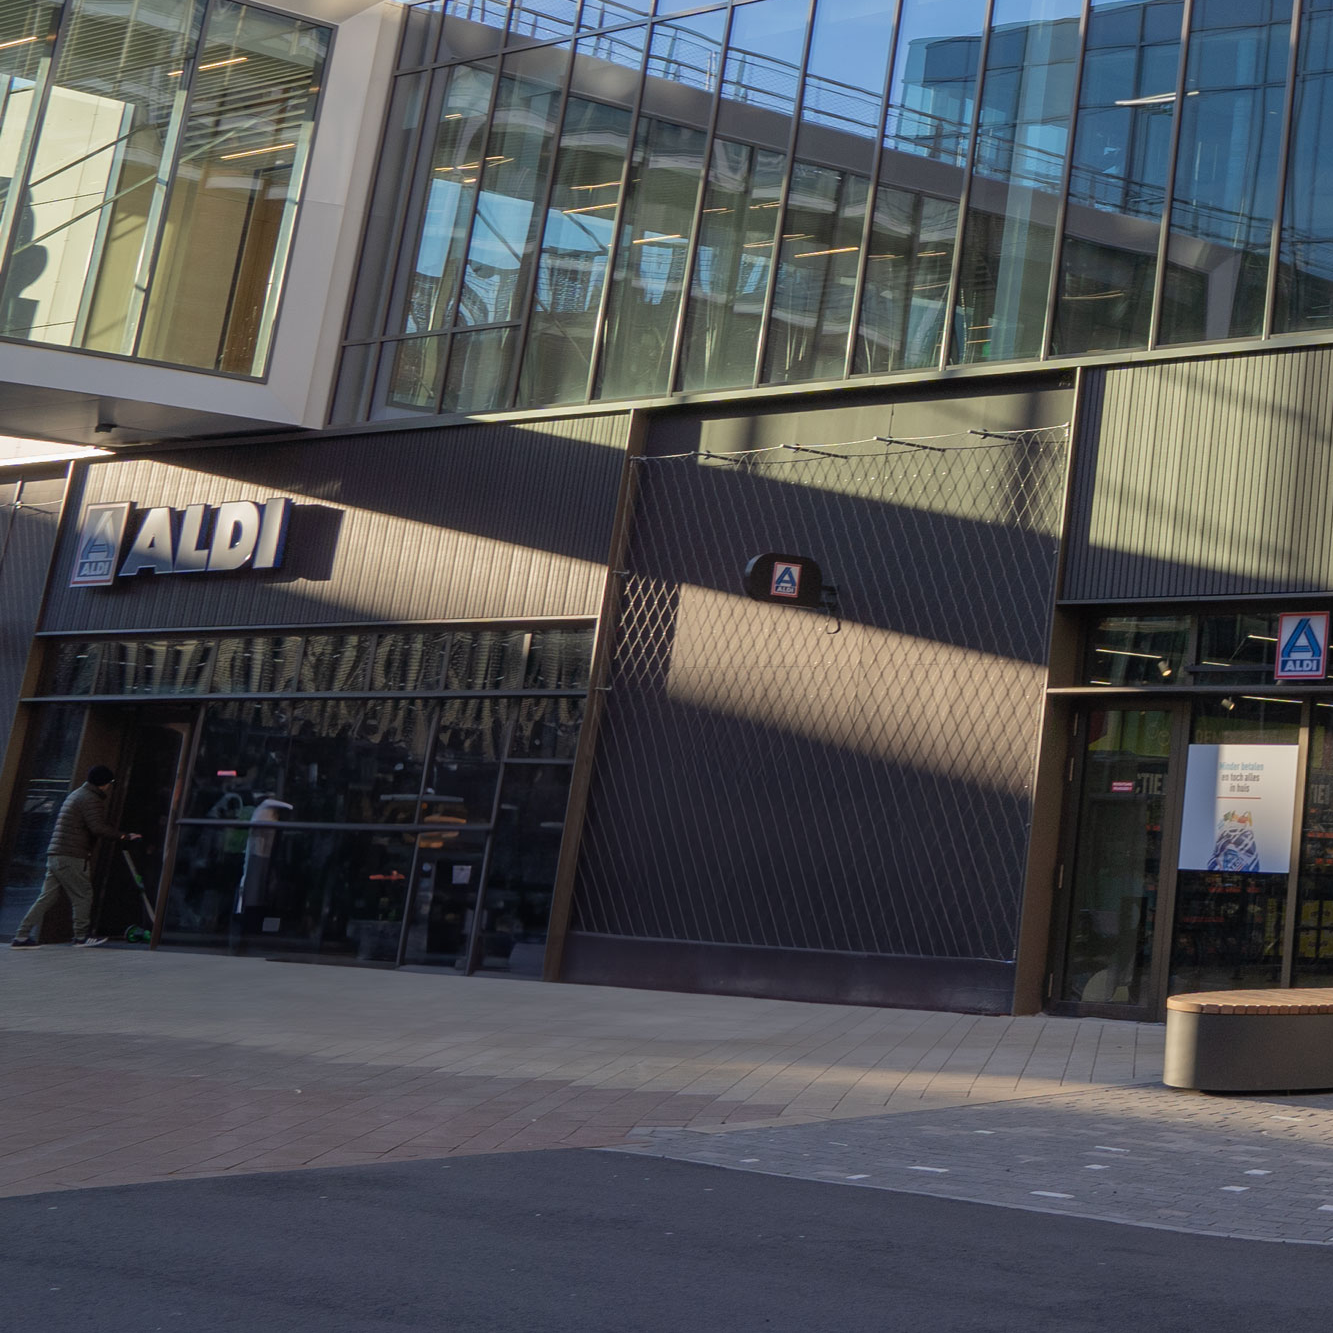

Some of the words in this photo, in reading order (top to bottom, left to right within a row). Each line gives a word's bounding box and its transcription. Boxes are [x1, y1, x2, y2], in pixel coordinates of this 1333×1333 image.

[117, 497, 291, 577] ALDI
[79, 561, 110, 577] ALDI
[1284, 660, 1318, 671] ALDI
[1230, 772, 1244, 782] toch
[1244, 772, 1260, 782] alles
[1236, 783, 1250, 793] huis
